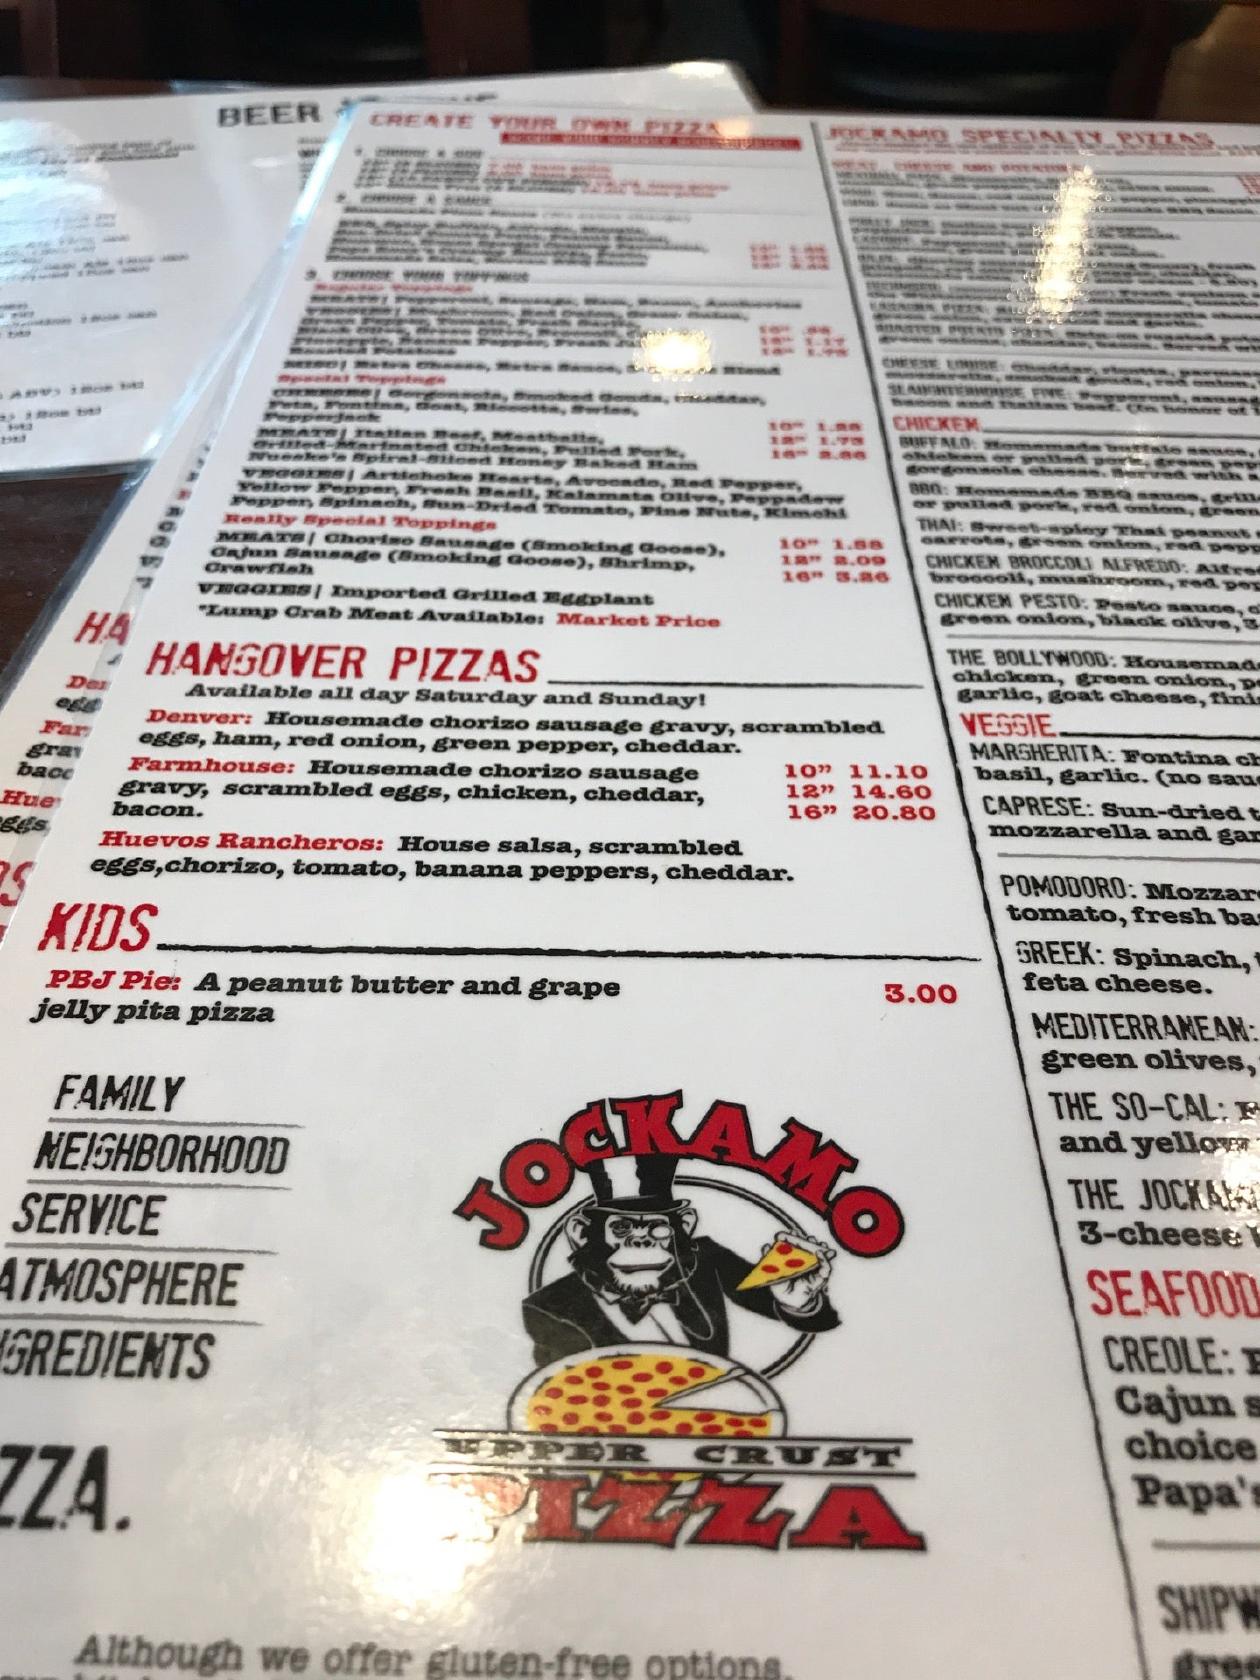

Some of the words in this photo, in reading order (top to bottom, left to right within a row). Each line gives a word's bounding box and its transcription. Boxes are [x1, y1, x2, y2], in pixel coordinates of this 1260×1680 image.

[218, 104, 320, 128] BEER
[370, 112, 473, 128] CREATE
[489, 114, 557, 130] YOUR
[893, 416, 979, 432] CHICKEN
[393, 516, 497, 532] Toppings
[325, 533, 414, 546] Chorizo
[419, 536, 515, 553] Sausage
[210, 547, 277, 560] Cajun
[284, 548, 381, 563] Sausage
[388, 550, 502, 567] (Smoking
[204, 563, 314, 576] Crawfish
[331, 585, 447, 600] Imported
[453, 588, 537, 603] Grilled
[542, 591, 655, 606] Eggplant
[935, 593, 1012, 610] CHICKEN
[284, 605, 341, 619] Crab
[348, 607, 413, 620] Meat
[418, 609, 544, 625] Available:
[556, 612, 650, 626] Market
[655, 614, 721, 627] Price
[146, 642, 366, 679] HANGOVER
[390, 645, 541, 683] PIZZAS
[947, 649, 985, 665] THE
[994, 649, 1116, 668] BOLLYWOOD:
[953, 670, 1064, 685] chicken,
[1076, 673, 1150, 686] green
[1154, 674, 1236, 689] onion,
[186, 684, 312, 699] Available
[319, 685, 355, 700] all
[361, 686, 410, 704] day
[415, 687, 538, 707] Saturday
[544, 692, 594, 704] and
[599, 692, 706, 709] Sunday!
[957, 688, 1042, 703] garlic,
[1048, 690, 1103, 704] goat
[1110, 690, 1206, 707] cheese,
[146, 709, 252, 725] Denver:
[265, 711, 423, 729] Housemade
[430, 713, 530, 731] chorizo
[536, 719, 643, 734] sausage
[650, 720, 735, 737] gravy,
[742, 720, 885, 734] scrambled
[960, 713, 1057, 737] VEGGIE
[139, 732, 207, 748] eggs,
[213, 731, 282, 749] ham,
[287, 733, 335, 747] red
[340, 734, 425, 751] onion,
[432, 737, 511, 752] green
[517, 739, 619, 755] pepper,
[625, 739, 741, 753] cheddar.
[969, 742, 1115, 762] MARGHERITA:
[1121, 749, 1230, 766] Fontina
[128, 757, 295, 774] Farmhouse:
[307, 760, 472, 777] Housemade
[479, 765, 582, 780] chorizo
[589, 767, 699, 783] sausage
[850, 765, 928, 779] 11.10
[974, 767, 1053, 785] basil,
[1060, 769, 1149, 785] garlic.
[1156, 769, 1201, 787] (no
[118, 779, 209, 797] gravy,
[223, 781, 373, 798] scrambled
[380, 785, 449, 802] eggs,
[457, 784, 578, 804] chicken,
[584, 787, 705, 806] cheddar,
[852, 785, 932, 799] 14.60
[112, 801, 204, 817] bacon.
[852, 805, 936, 821] 20.80
[982, 796, 1094, 817] CAPRESE:
[1101, 803, 1244, 821] Sun-dried
[98, 832, 209, 848] Huevos
[216, 834, 384, 851] Rancheros:
[398, 836, 490, 854] House
[498, 838, 581, 856] salsa,
[589, 839, 743, 856] scrambled
[989, 824, 1150, 840] mozzarella
[1157, 826, 1211, 841] and
[293, 861, 406, 880] tomato,
[415, 862, 523, 880] banana
[530, 866, 658, 885] peppers,
[666, 865, 794, 881] cheddar.
[1000, 875, 1136, 899] POMODORO:
[38, 903, 158, 951] KIDS
[1006, 905, 1127, 927] tomato,
[1131, 906, 1216, 925] fresh
[1015, 940, 1104, 965] GREEK:
[1112, 948, 1251, 974] Spinach,
[46, 970, 114, 989] PBJ
[120, 971, 180, 990] Pie:
[194, 972, 220, 992] A
[228, 974, 342, 996] peanut
[352, 975, 453, 995] butter
[461, 976, 521, 996] and
[529, 979, 620, 1000] grape
[885, 984, 957, 1004] 3.00
[1022, 972, 1088, 991] feta
[1095, 974, 1213, 994] cheese.
[30, 1000, 109, 1024] jelly
[115, 1001, 180, 1024] pita
[187, 1002, 275, 1025] pizza
[1032, 1012, 1258, 1041] MEDITERRANEAN:
[1041, 1050, 1138, 1074] green
[1145, 1048, 1256, 1077] olives,
[54, 1075, 185, 1112] FAMILY
[1048, 1092, 1102, 1120] THE
[1112, 1092, 1229, 1121] SO-CAL:
[34, 1131, 290, 1174] NEIGHBORHOOD
[1059, 1131, 1127, 1153] and
[1131, 1131, 1250, 1159] yellow
[453, 1089, 905, 1258] JOCKAMO
[1067, 1179, 1124, 1210] THE
[12, 1193, 167, 1235] SERVICE
[1078, 1220, 1243, 1247] 3-cheese
[0, 1257, 244, 1306] ATMOSPHERE
[1087, 1269, 1260, 1318] SEAFOOD
[1103, 1335, 1235, 1375] CREOLE:
[1115, 1384, 1236, 1424] Cajun
[443, 1438, 650, 1462] UPPER
[694, 1446, 900, 1467] CRUST
[1125, 1428, 1257, 1461] choice
[74, 1636, 243, 1672] Although
[258, 1644, 308, 1672] we
[324, 1641, 411, 1674] offer
[428, 1646, 630, 1680] gluten-free
